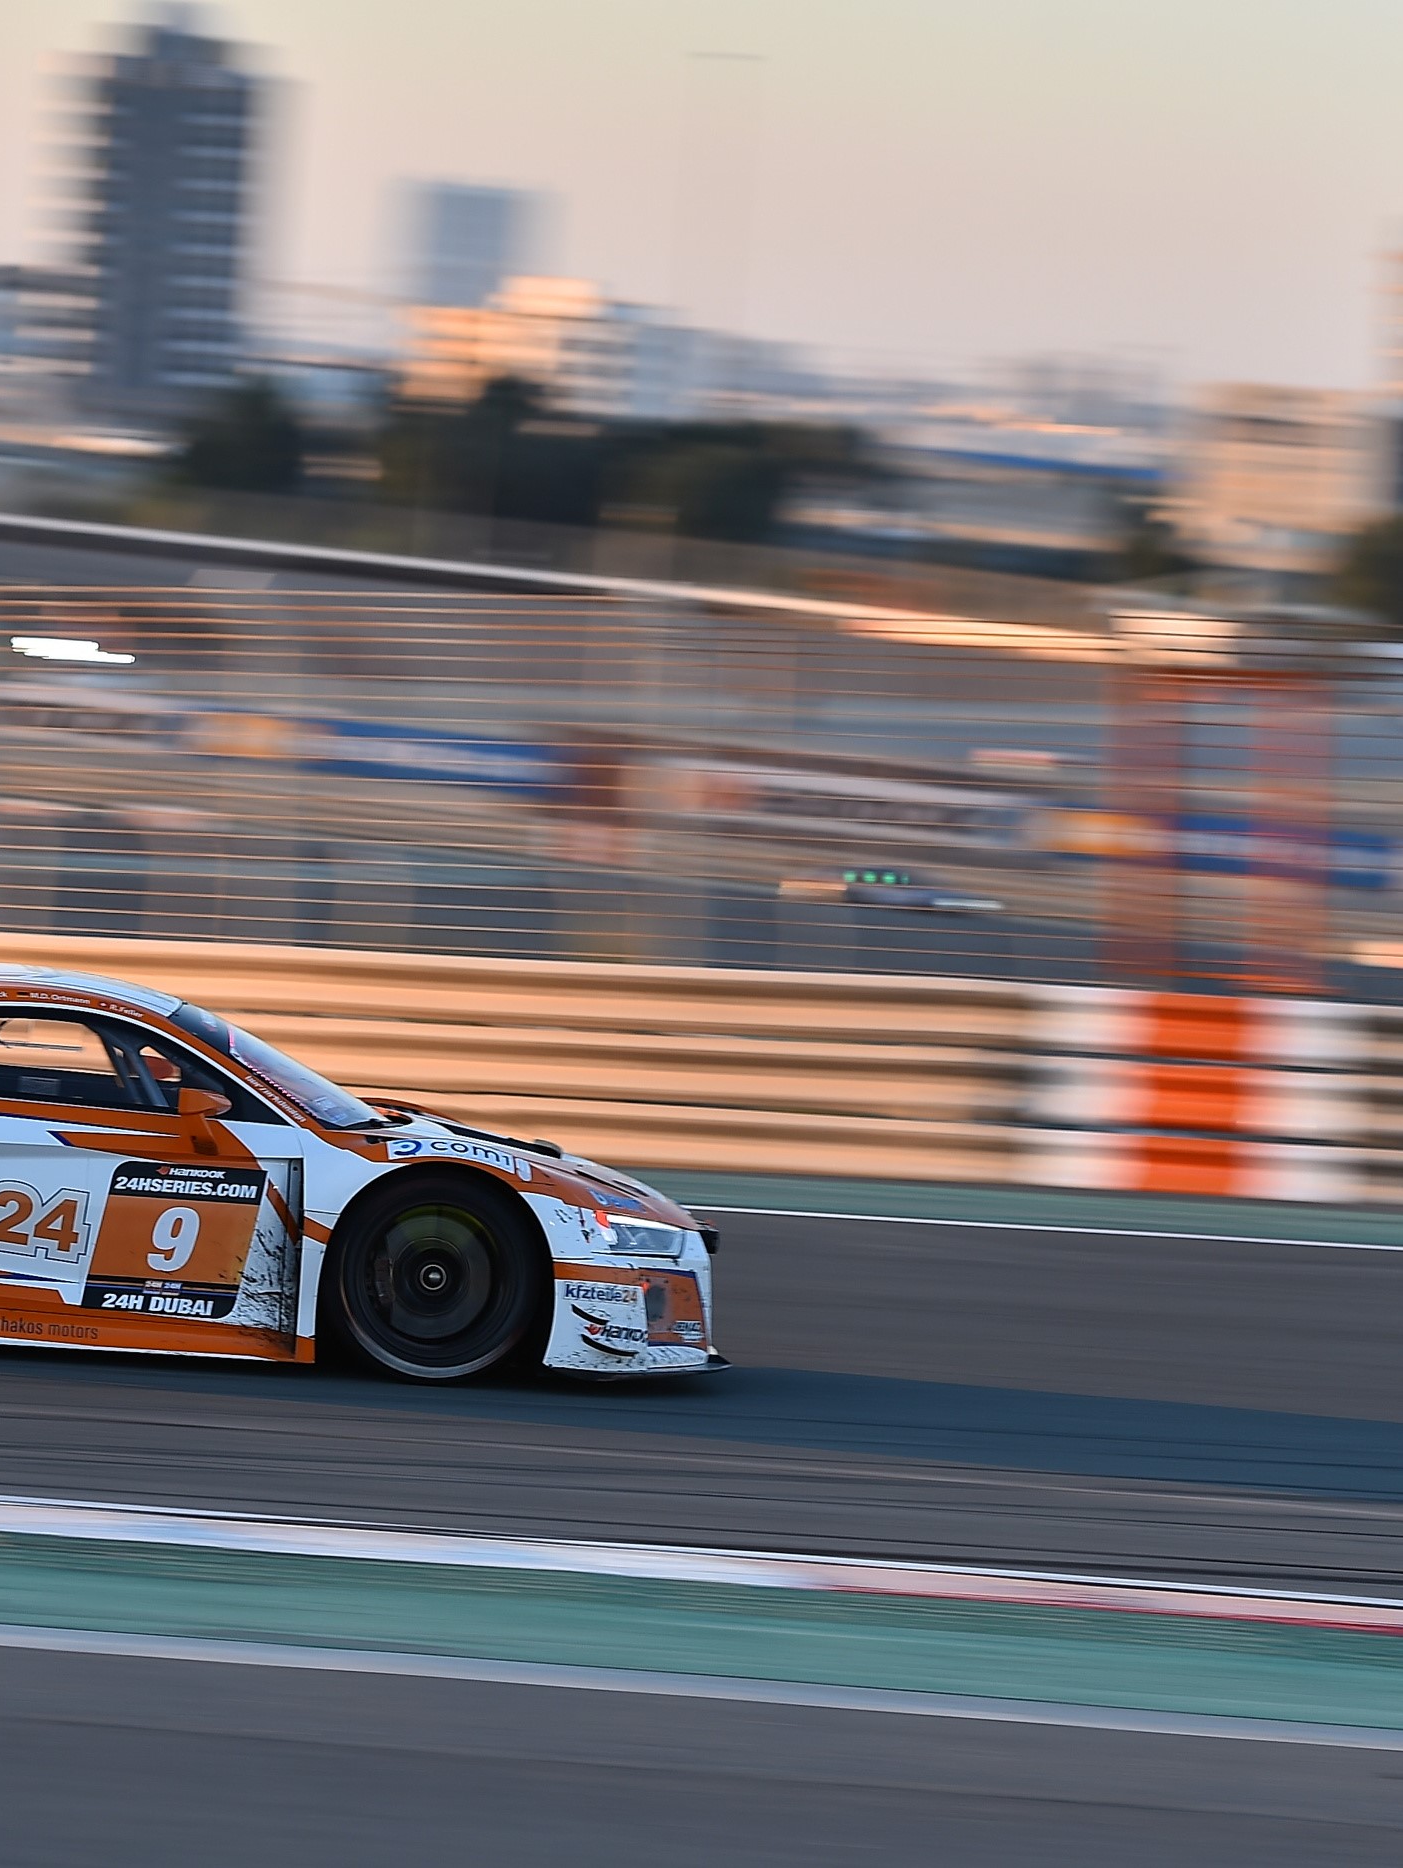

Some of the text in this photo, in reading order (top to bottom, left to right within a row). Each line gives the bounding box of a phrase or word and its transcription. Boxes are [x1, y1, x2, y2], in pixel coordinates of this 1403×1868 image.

[114, 1176, 258, 1199] 24HSERIES.COM
[147, 1206, 201, 1273] 9
[101, 1293, 215, 1316] 24H DUBAI
[564, 1283, 638, 1303] kfzteile24
[48, 1323, 99, 1340] motors
